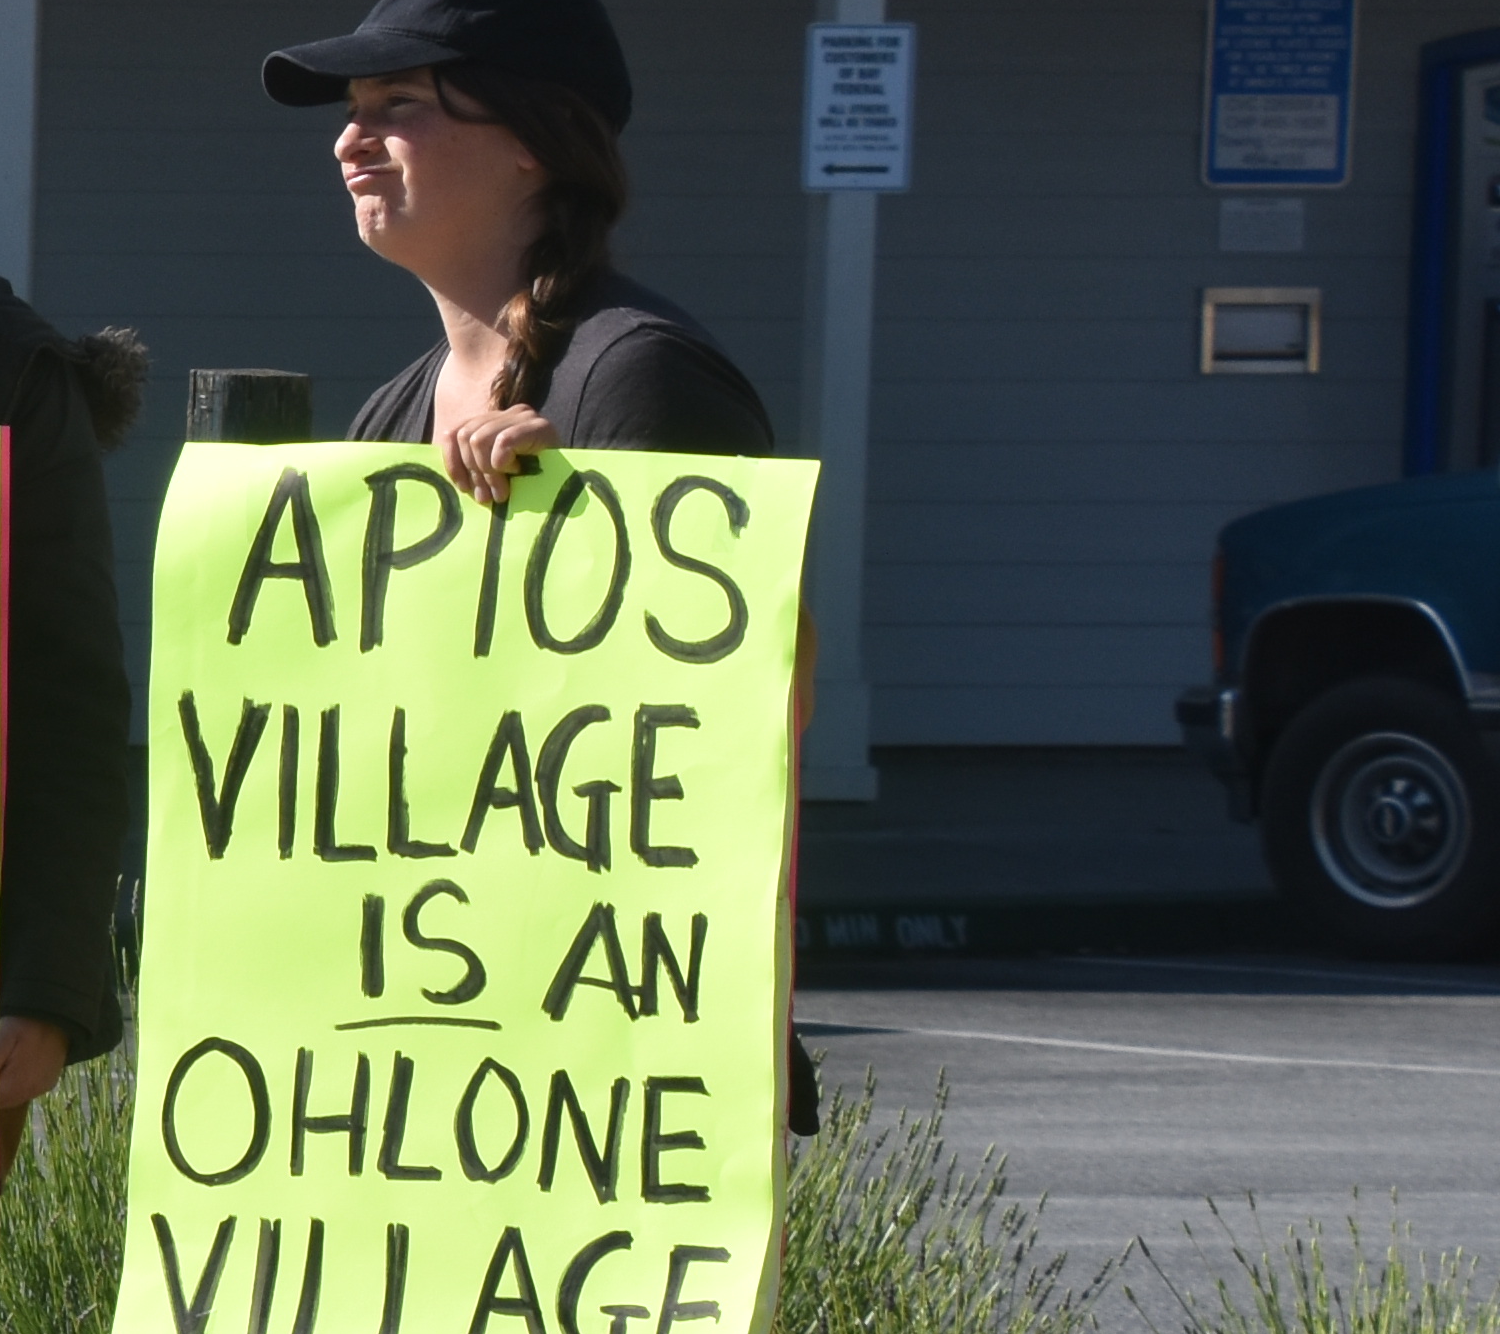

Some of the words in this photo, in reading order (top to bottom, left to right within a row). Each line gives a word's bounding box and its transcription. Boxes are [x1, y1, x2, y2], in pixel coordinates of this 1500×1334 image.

[227, 454, 749, 664] APTOS
[178, 689, 700, 872] VILLAGE
[358, 878, 488, 1006] IS
[542, 902, 708, 1022] AN
[161, 1036, 711, 1204] OHLONE
